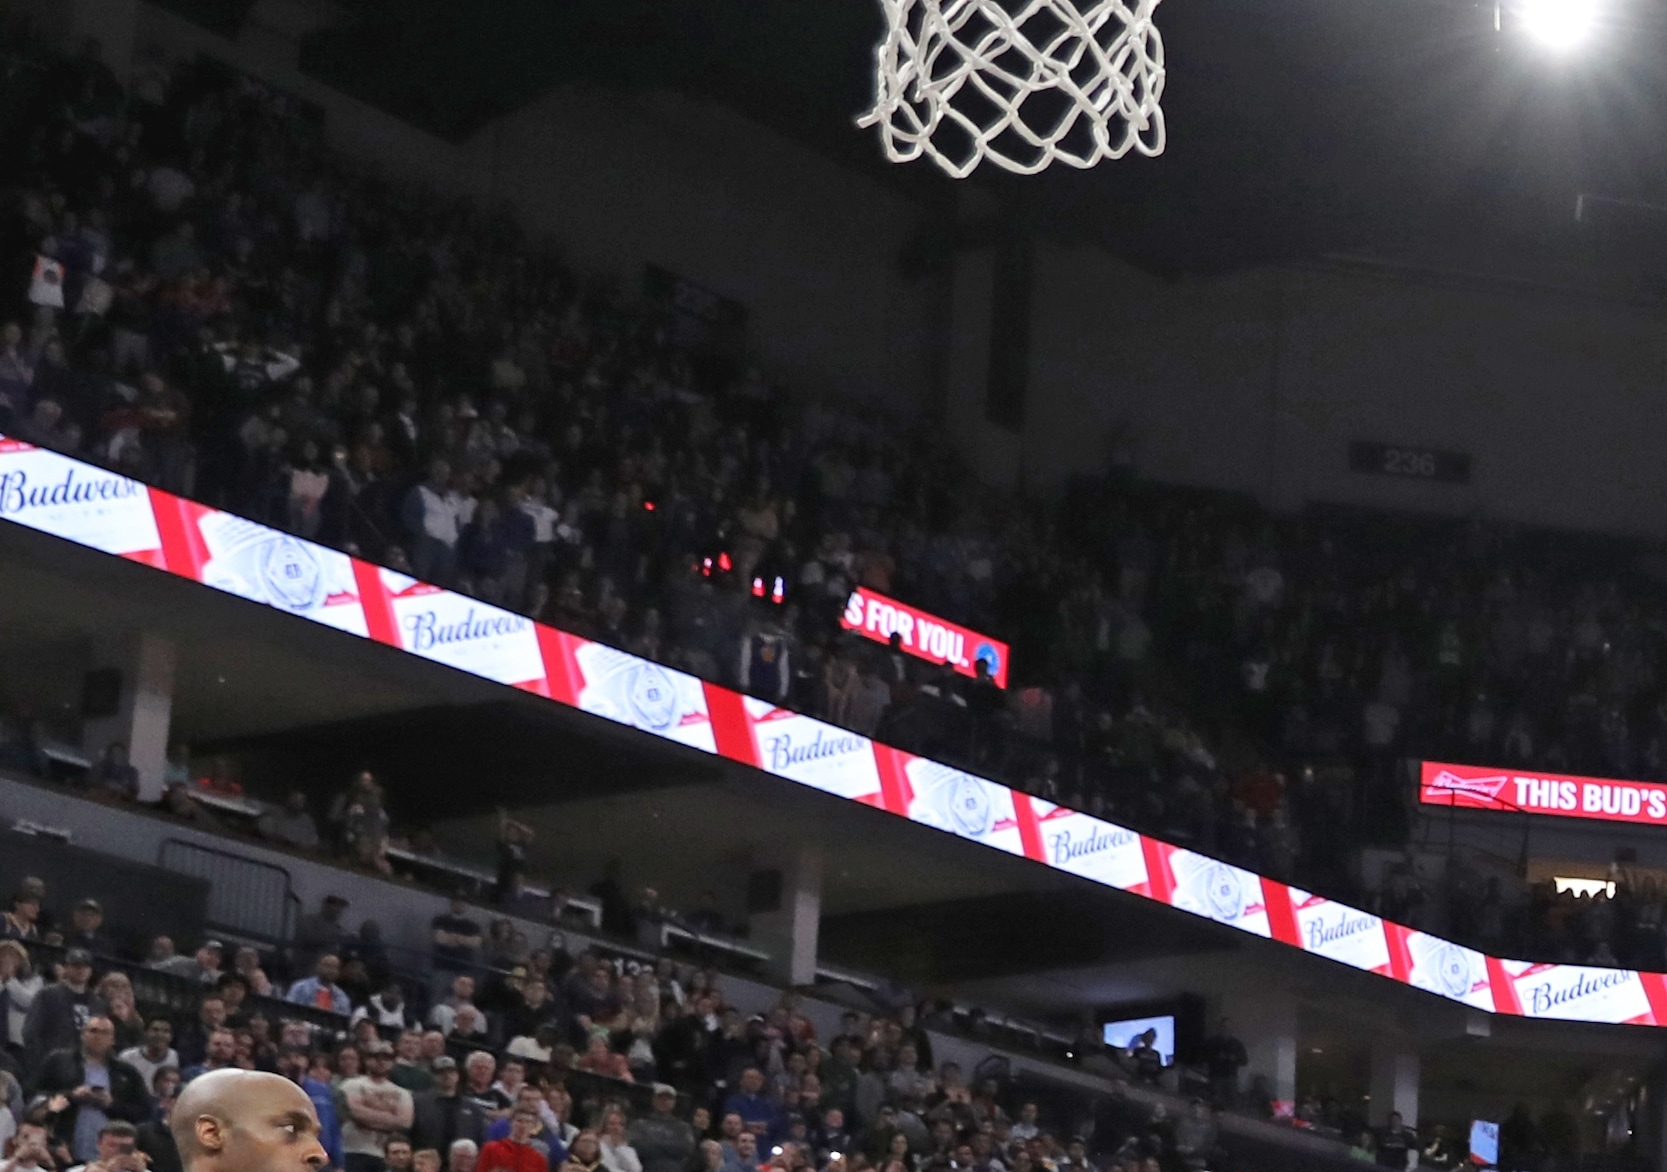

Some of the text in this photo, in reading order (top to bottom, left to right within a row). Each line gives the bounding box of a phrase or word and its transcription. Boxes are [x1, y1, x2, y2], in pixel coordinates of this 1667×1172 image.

[867, 599, 915, 648] FOR
[915, 614, 970, 670] YOU.
[1513, 775, 1578, 814] THIS
[1581, 780, 1667, 820] BUD'S
